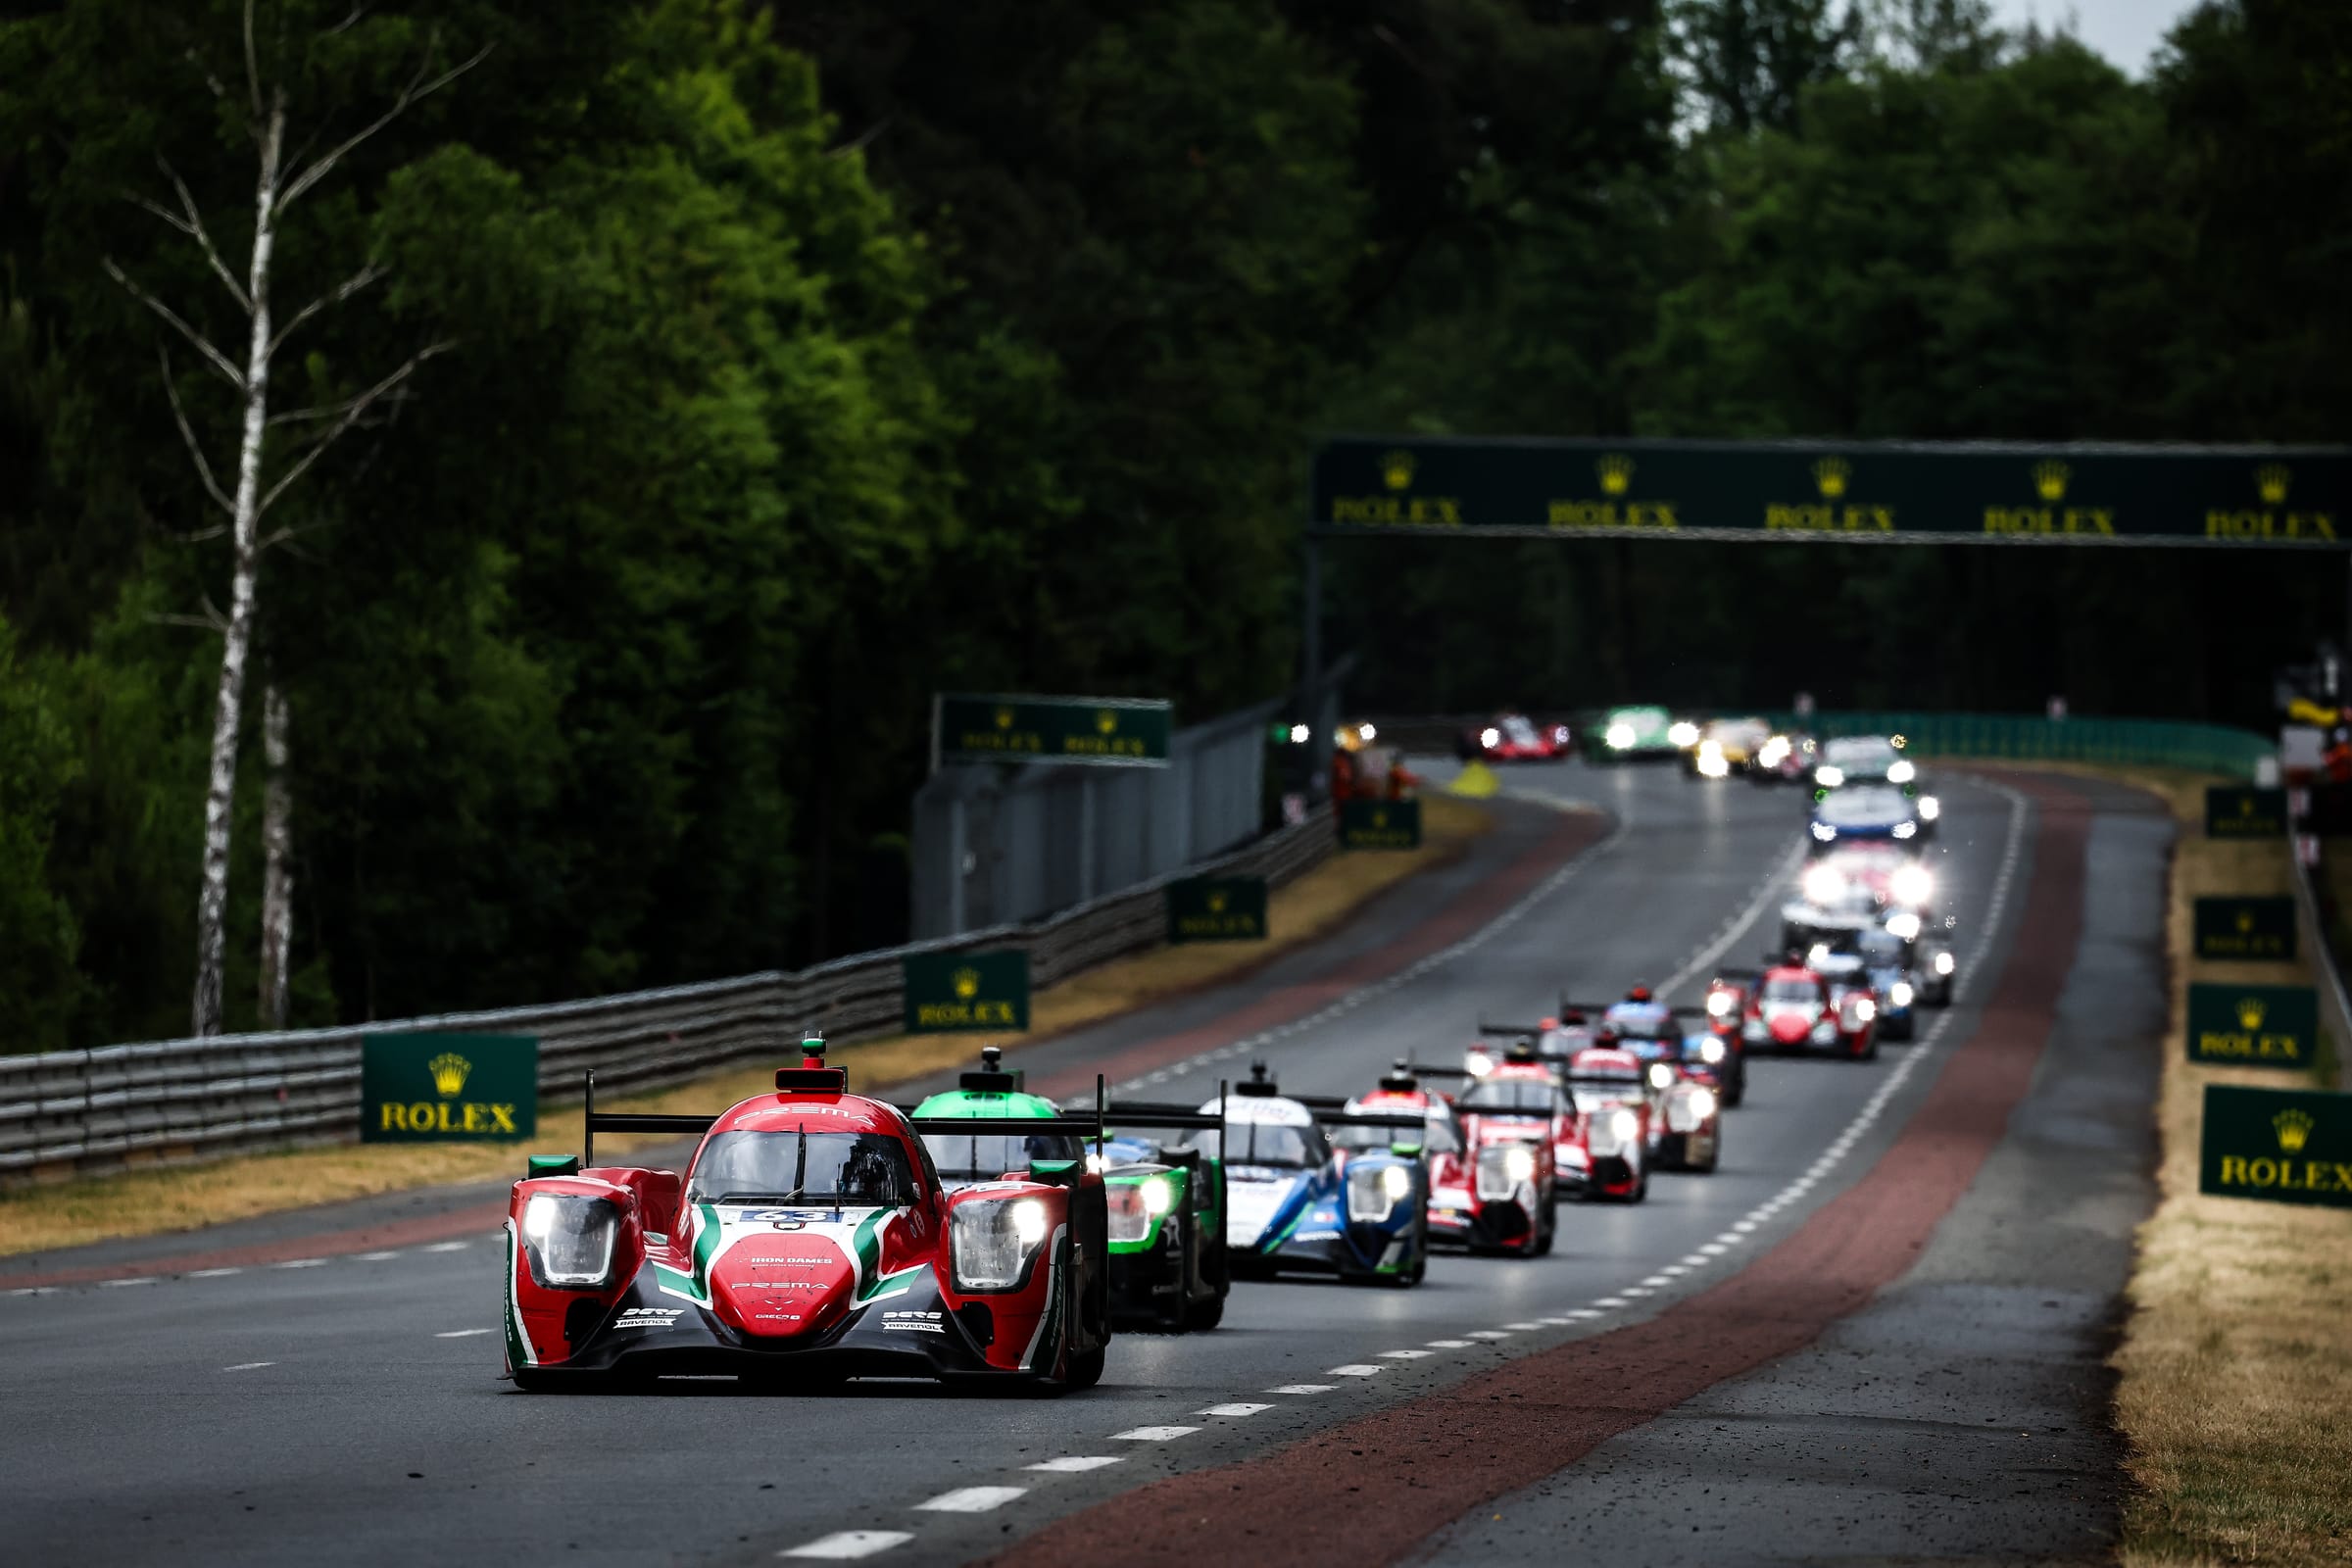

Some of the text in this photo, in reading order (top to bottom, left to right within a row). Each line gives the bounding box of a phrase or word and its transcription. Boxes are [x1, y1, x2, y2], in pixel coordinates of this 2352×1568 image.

[1549, 501, 1678, 529] ROLEX
[1767, 503, 1896, 531] ROLEX
[1984, 507, 2114, 536] ROLEX
[2205, 510, 2336, 543] ROLEX
[919, 1003, 1015, 1025] ROLEX
[2200, 1033, 2298, 1057] ROLEX
[380, 1102, 516, 1133] ROLEX
[734, 1106, 876, 1127] PREMA
[2221, 1154, 2352, 1192] ROLEX
[754, 1210, 828, 1222] 63
[619, 1318, 669, 1327] RAVENOL
